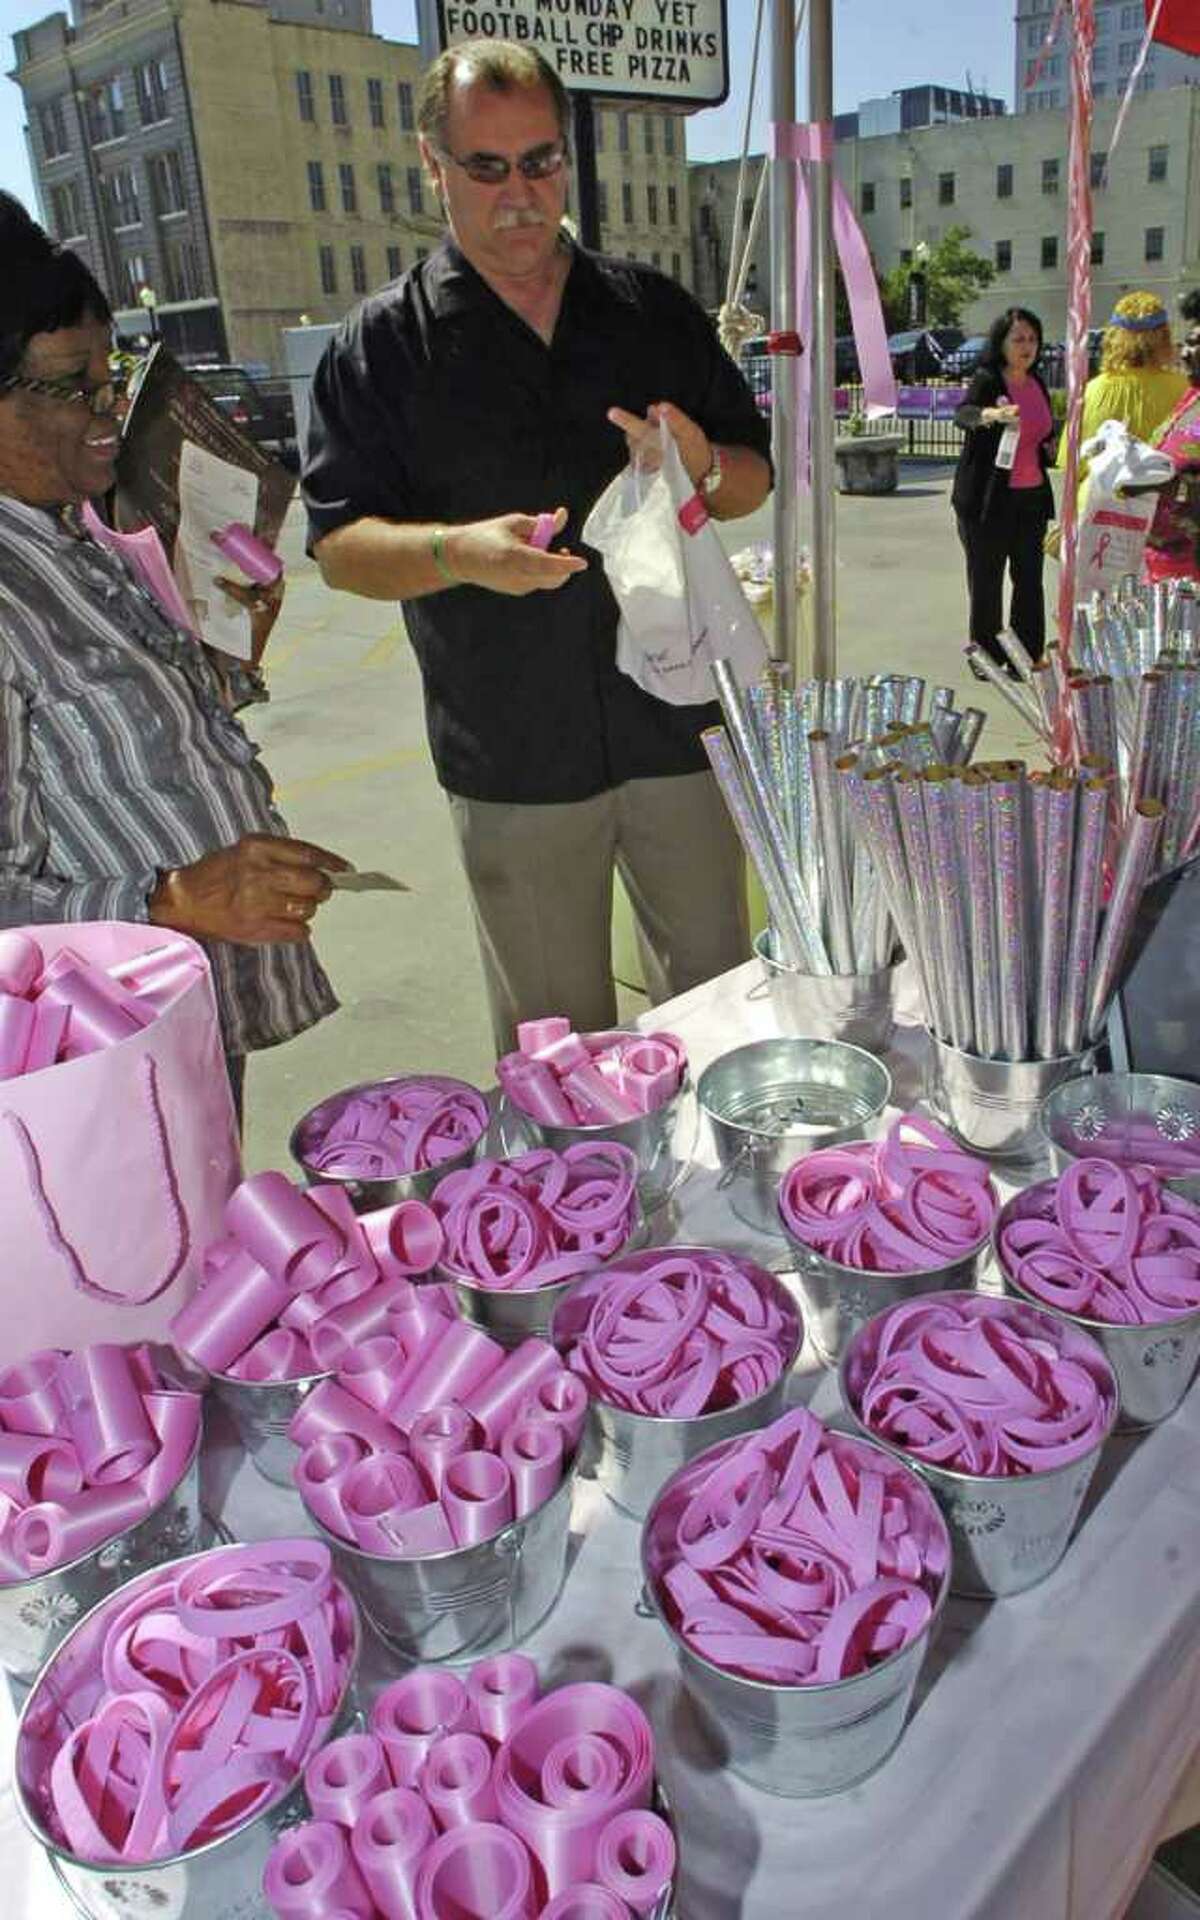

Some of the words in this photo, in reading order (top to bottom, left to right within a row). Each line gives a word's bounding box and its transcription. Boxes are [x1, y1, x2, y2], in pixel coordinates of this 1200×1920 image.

[655, 1, 696, 26] YET
[447, 8, 578, 44] FOOTBALL
[585, 22, 624, 48] CHP
[635, 27, 717, 57] DRINKS
[556, 48, 614, 76] FREE
[628, 55, 691, 83] PIZZA
